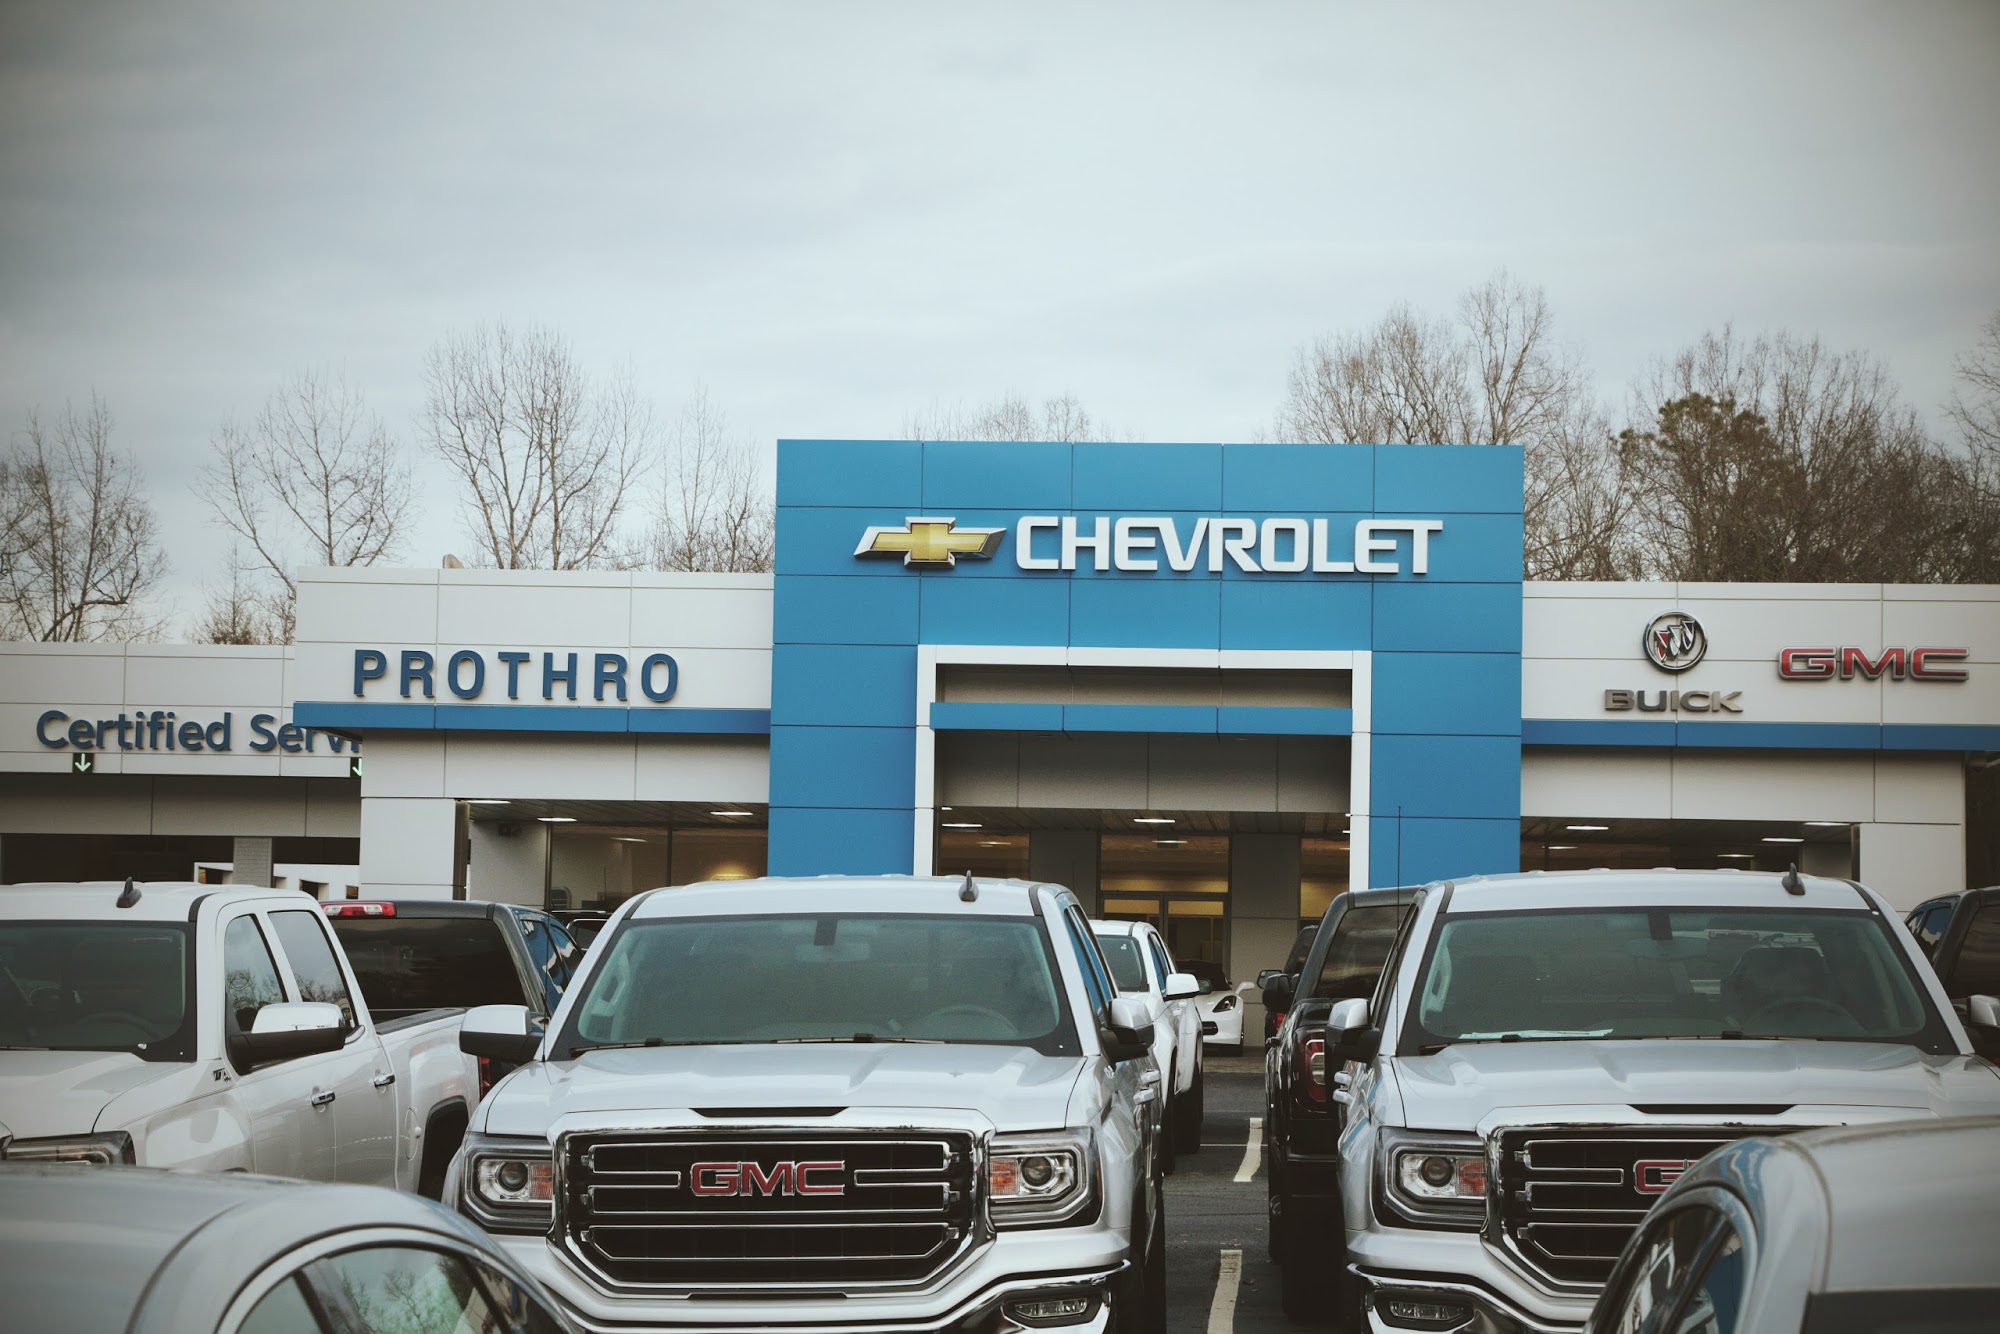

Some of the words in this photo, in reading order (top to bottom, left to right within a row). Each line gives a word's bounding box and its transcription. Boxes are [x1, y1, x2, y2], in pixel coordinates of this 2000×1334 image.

[1015, 516, 1443, 575] CHEVROLET
[353, 649, 679, 702] PROTHRO
[1779, 646, 1970, 681] GMC
[1605, 689, 1744, 713] BUICK
[36, 710, 232, 751] Certified
[690, 1161, 845, 1197] GMC
